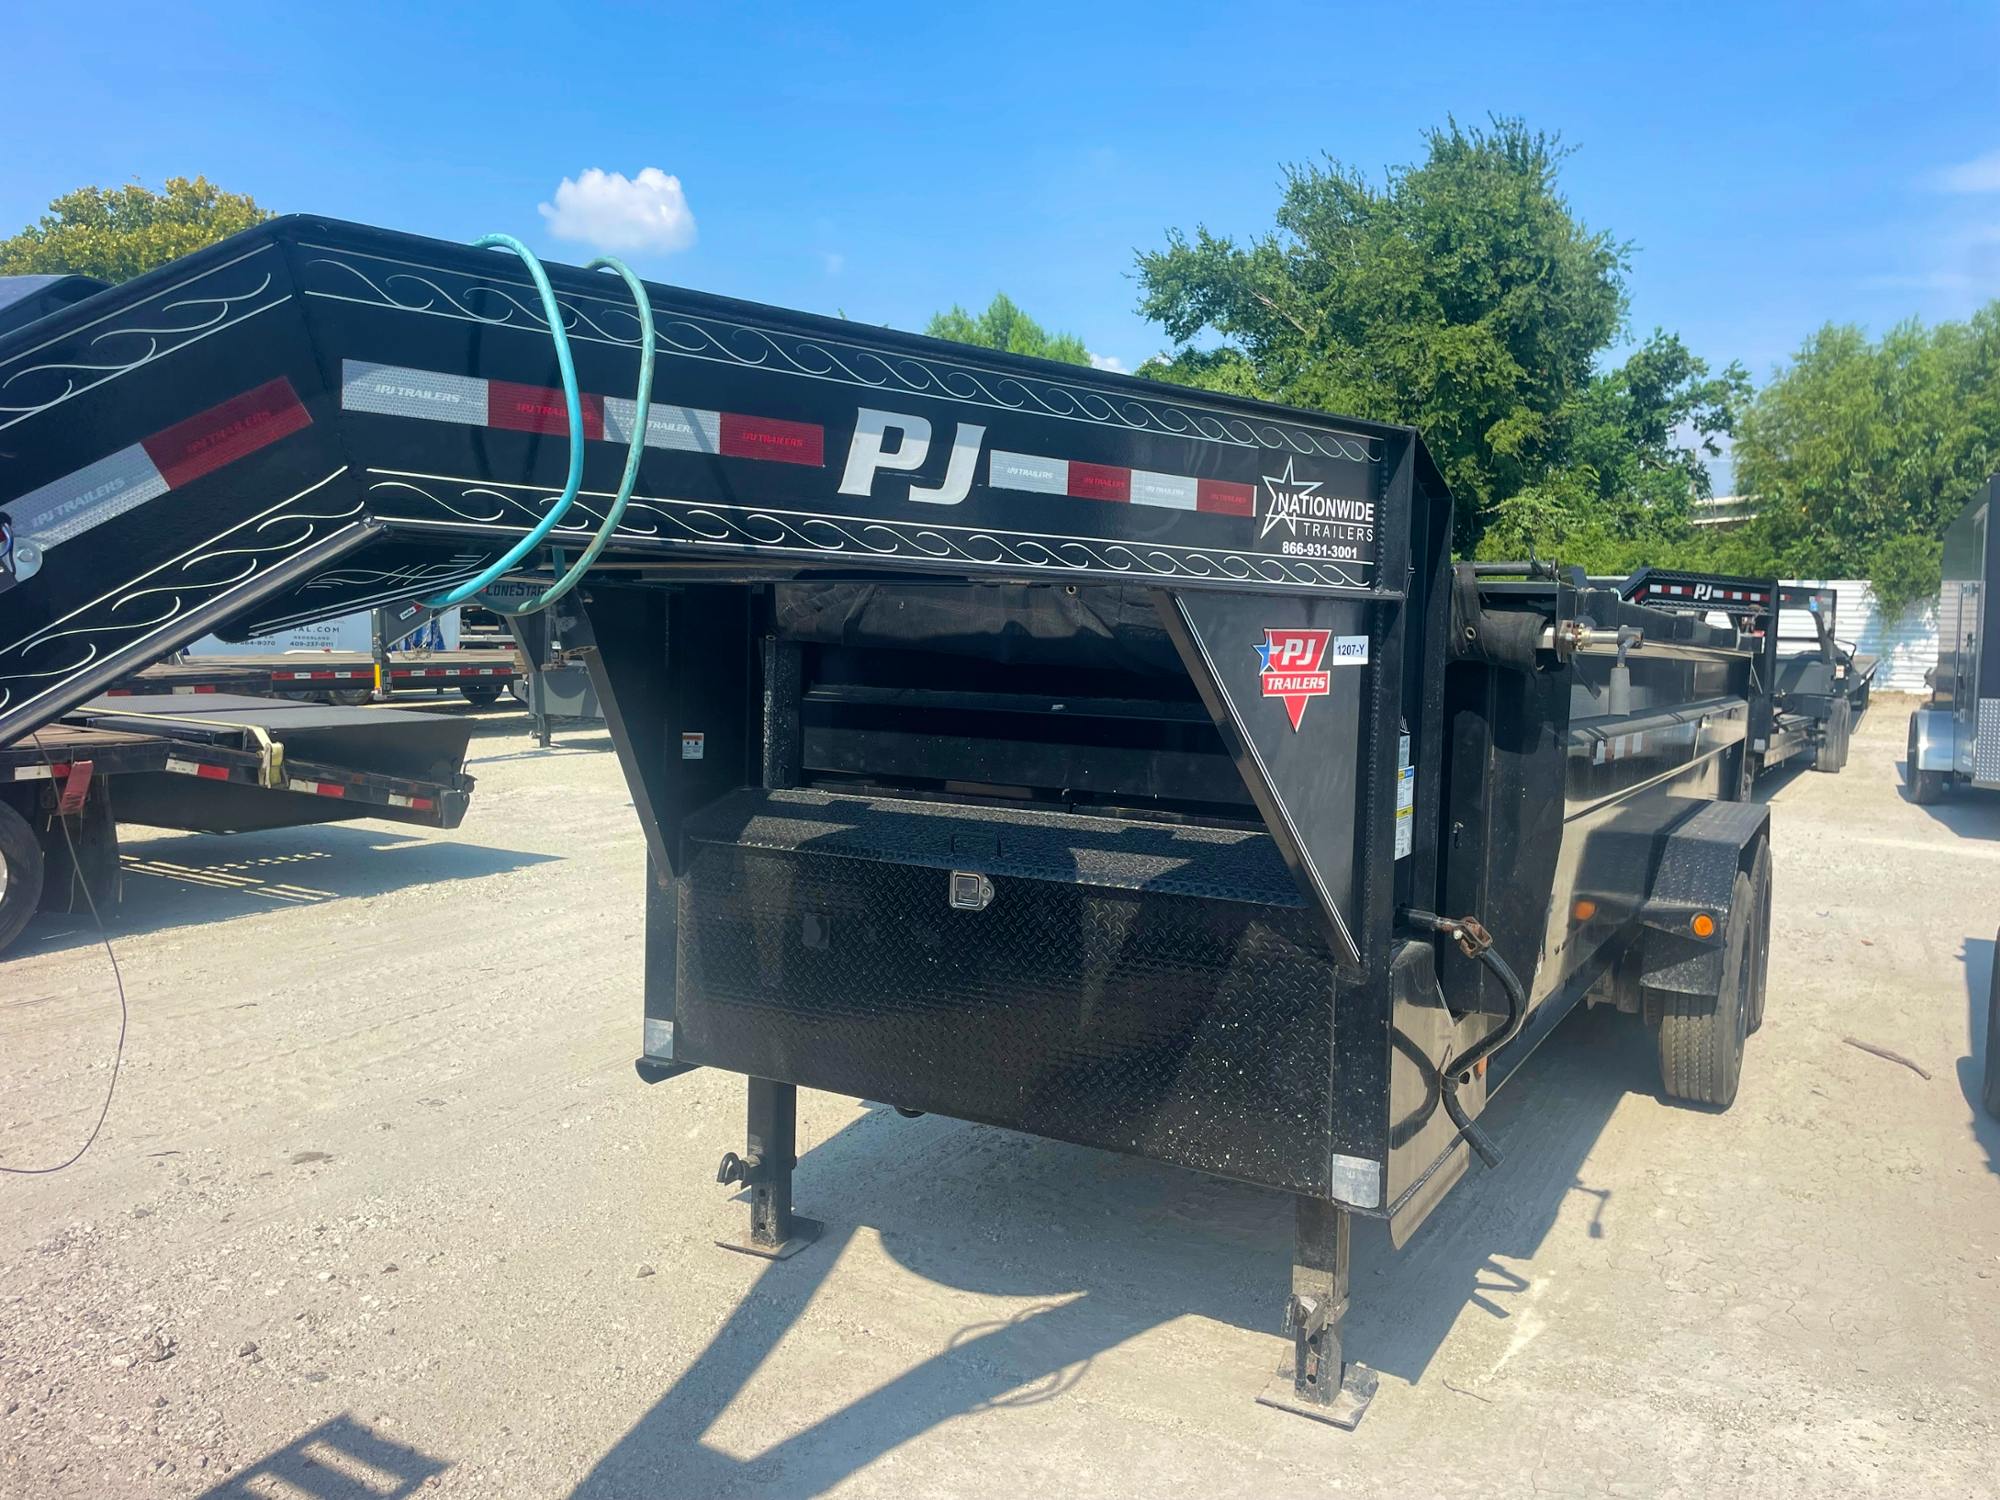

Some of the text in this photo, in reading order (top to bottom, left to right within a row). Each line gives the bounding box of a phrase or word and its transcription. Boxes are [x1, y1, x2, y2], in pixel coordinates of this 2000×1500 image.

[397, 387, 461, 403] TRAILERS
[838, 407, 986, 505] PJ
[54, 477, 126, 518] TRAILERS
[1278, 491, 1375, 522] NATIONWIDE
[1303, 521, 1374, 542] TRAILERS
[1282, 540, 1358, 559] 866-931-3001
[1694, 583, 1712, 601] PJ
[1281, 638, 1317, 666] PJ
[1337, 643, 1365, 657] 1207-Y
[1267, 677, 1327, 691] TRAILERS
